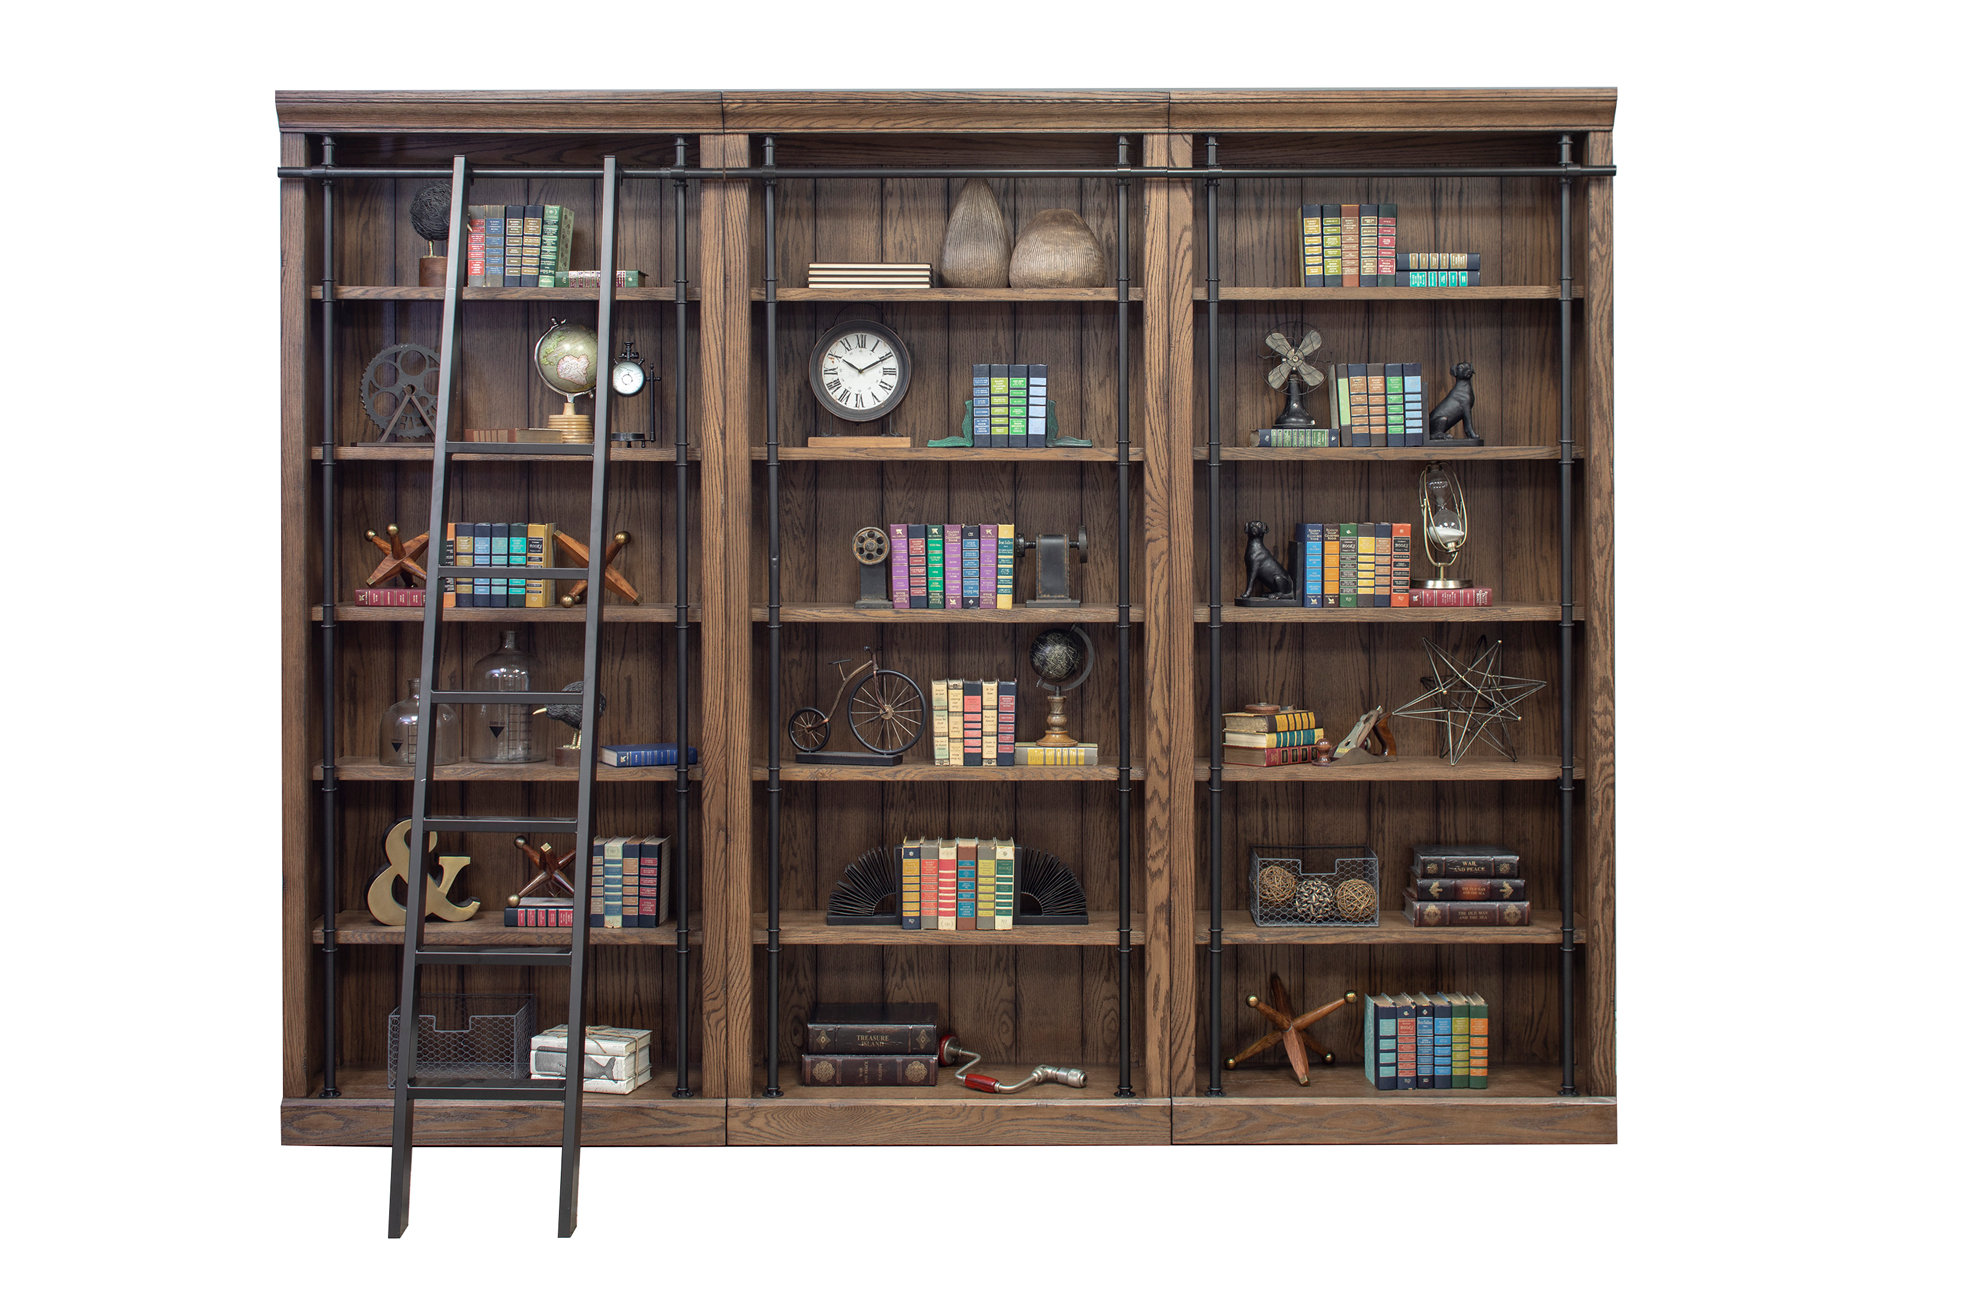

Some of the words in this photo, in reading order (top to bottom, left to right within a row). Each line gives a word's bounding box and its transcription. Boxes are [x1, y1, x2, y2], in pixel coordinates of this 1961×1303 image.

[839, 337, 853, 354] XI
[855, 334, 867, 349] XII
[870, 339, 880, 352] I
[826, 350, 842, 362] X
[883, 367, 897, 376] III
[855, 393, 865, 408] VI
[366, 817, 480, 926] &
